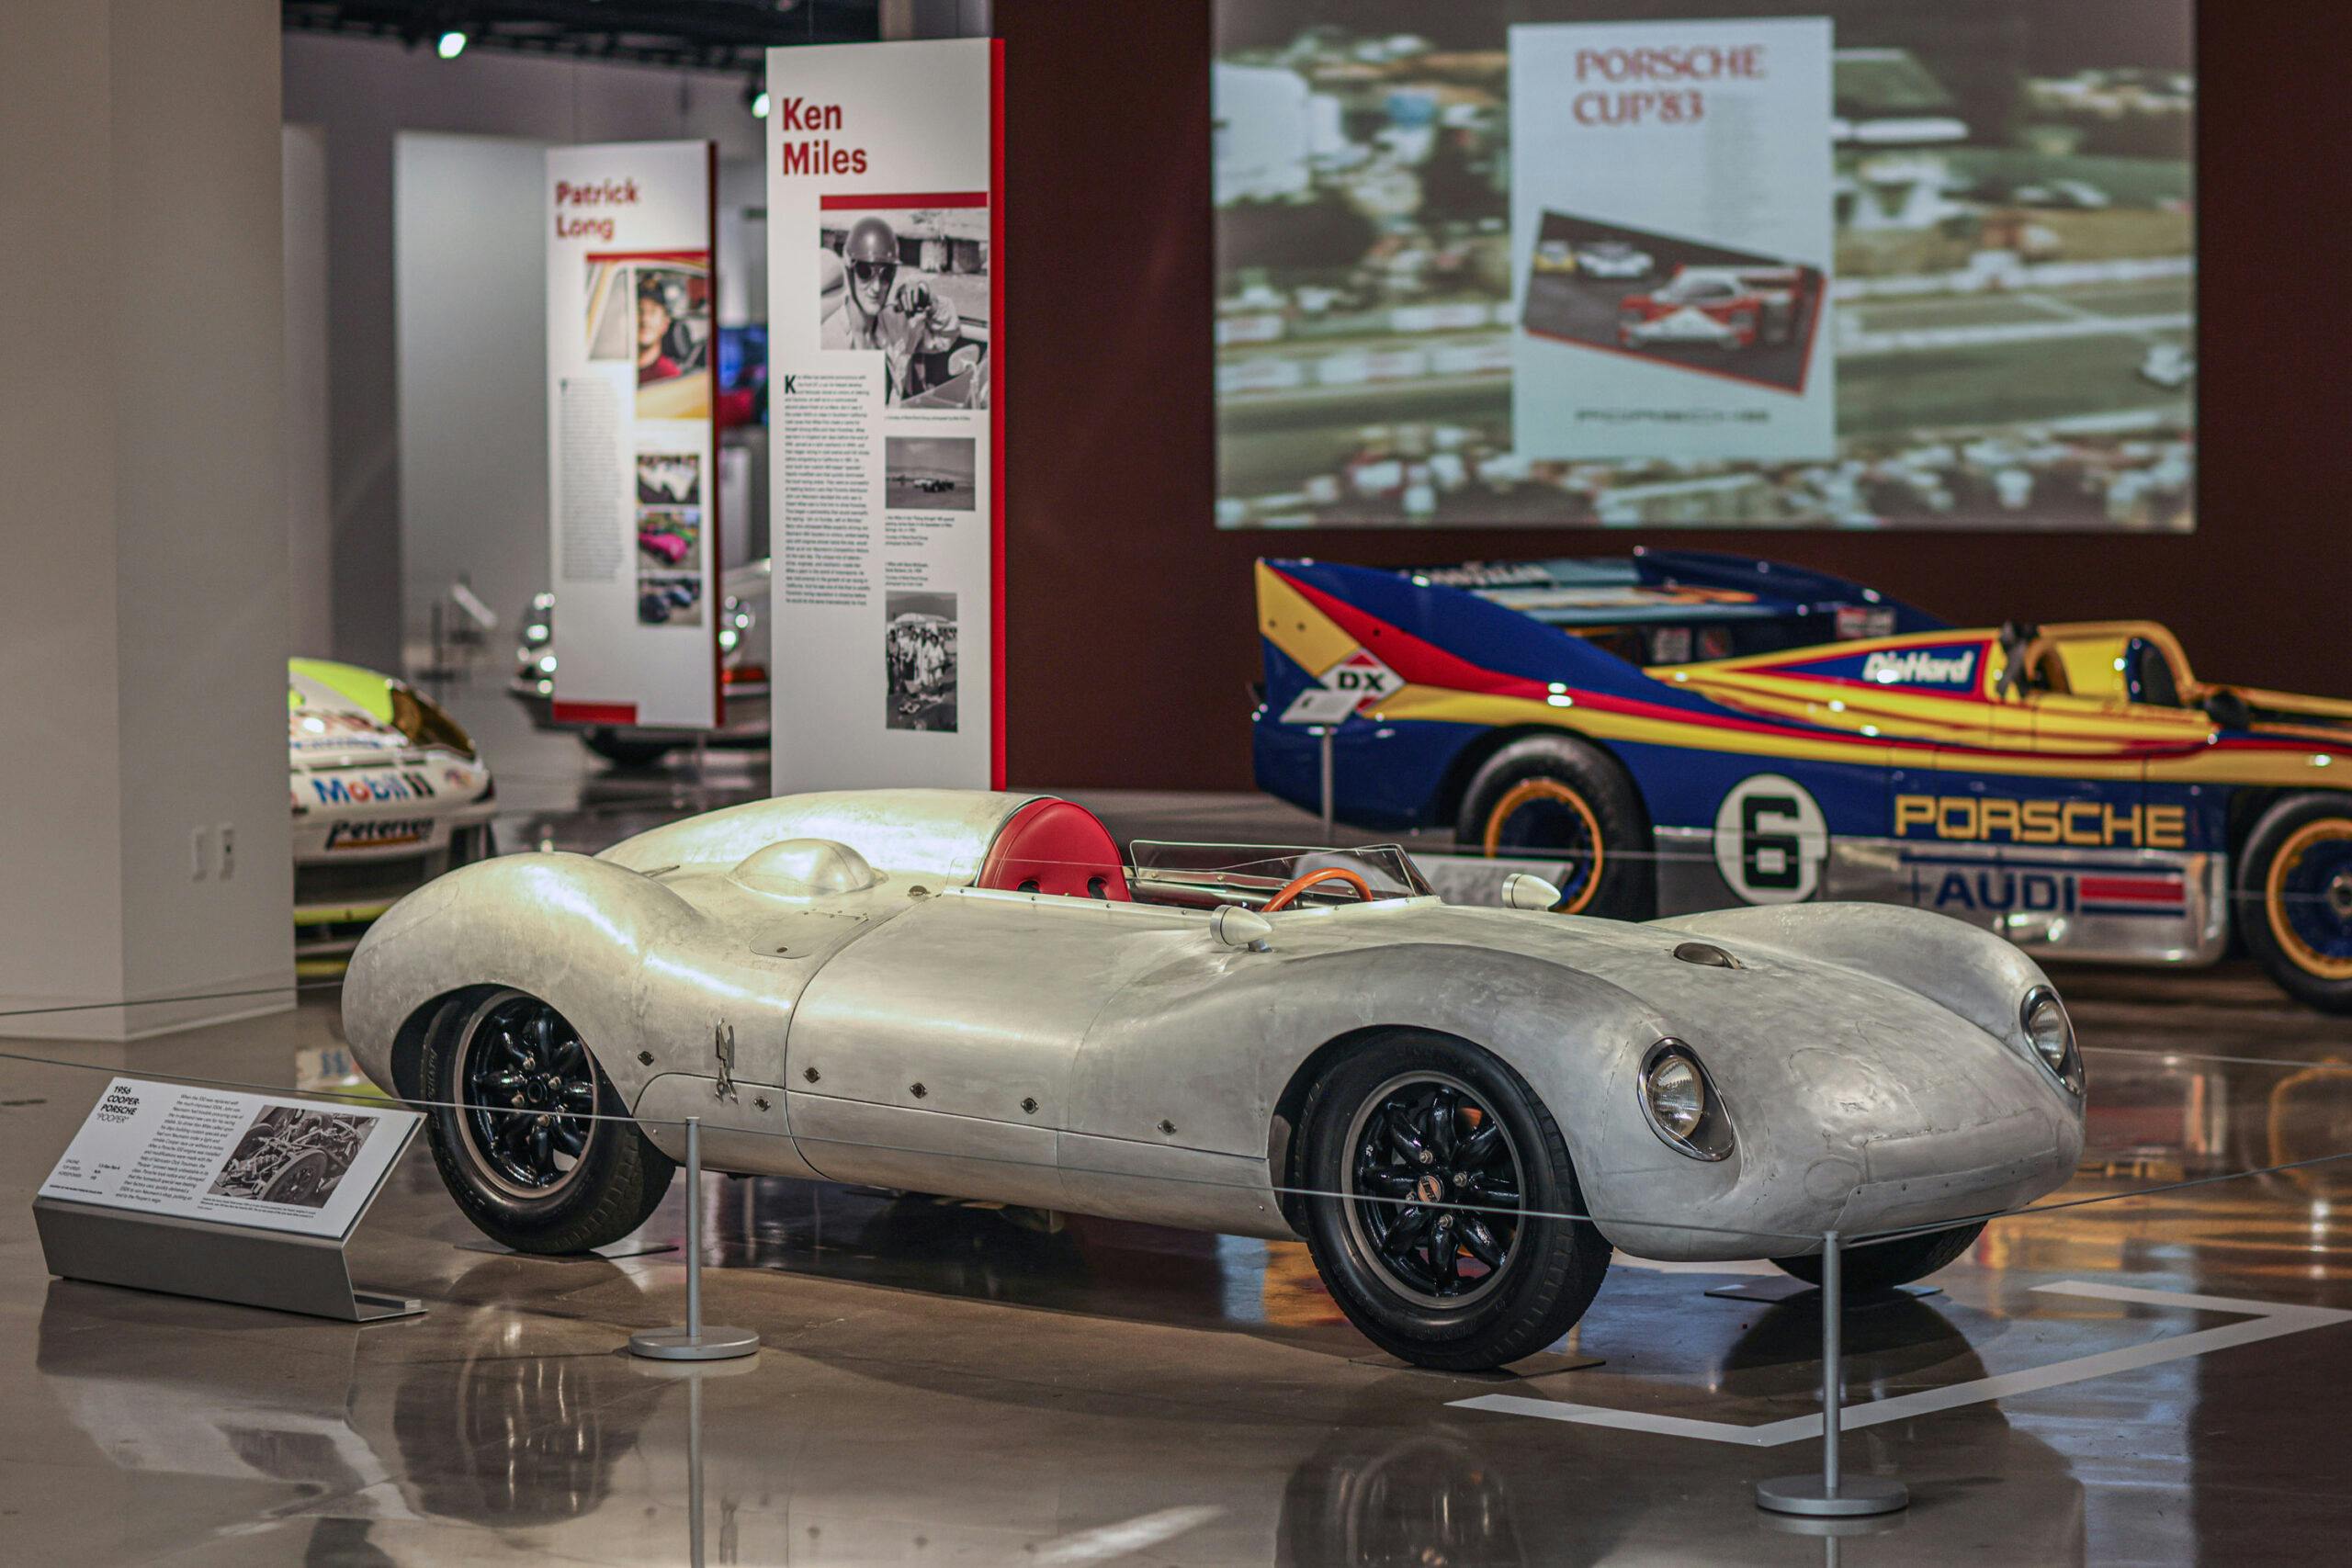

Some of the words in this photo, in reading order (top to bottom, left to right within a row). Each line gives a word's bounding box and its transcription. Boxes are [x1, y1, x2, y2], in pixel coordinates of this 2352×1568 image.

[1575, 46, 1768, 83] PORSCHE
[783, 96, 842, 131] Ken
[783, 140, 868, 175] Miles
[555, 178, 639, 206] Patrick
[555, 213, 616, 242] Long
[1338, 671, 1386, 693] DX
[1863, 650, 1974, 683] DieHard
[311, 773, 410, 805] Mobil
[1894, 794, 2187, 848] PORSCHE
[1742, 794, 1801, 889] 6
[114, 1086, 132, 1094] 1956
[101, 1105, 137, 1115] PORSCHE
